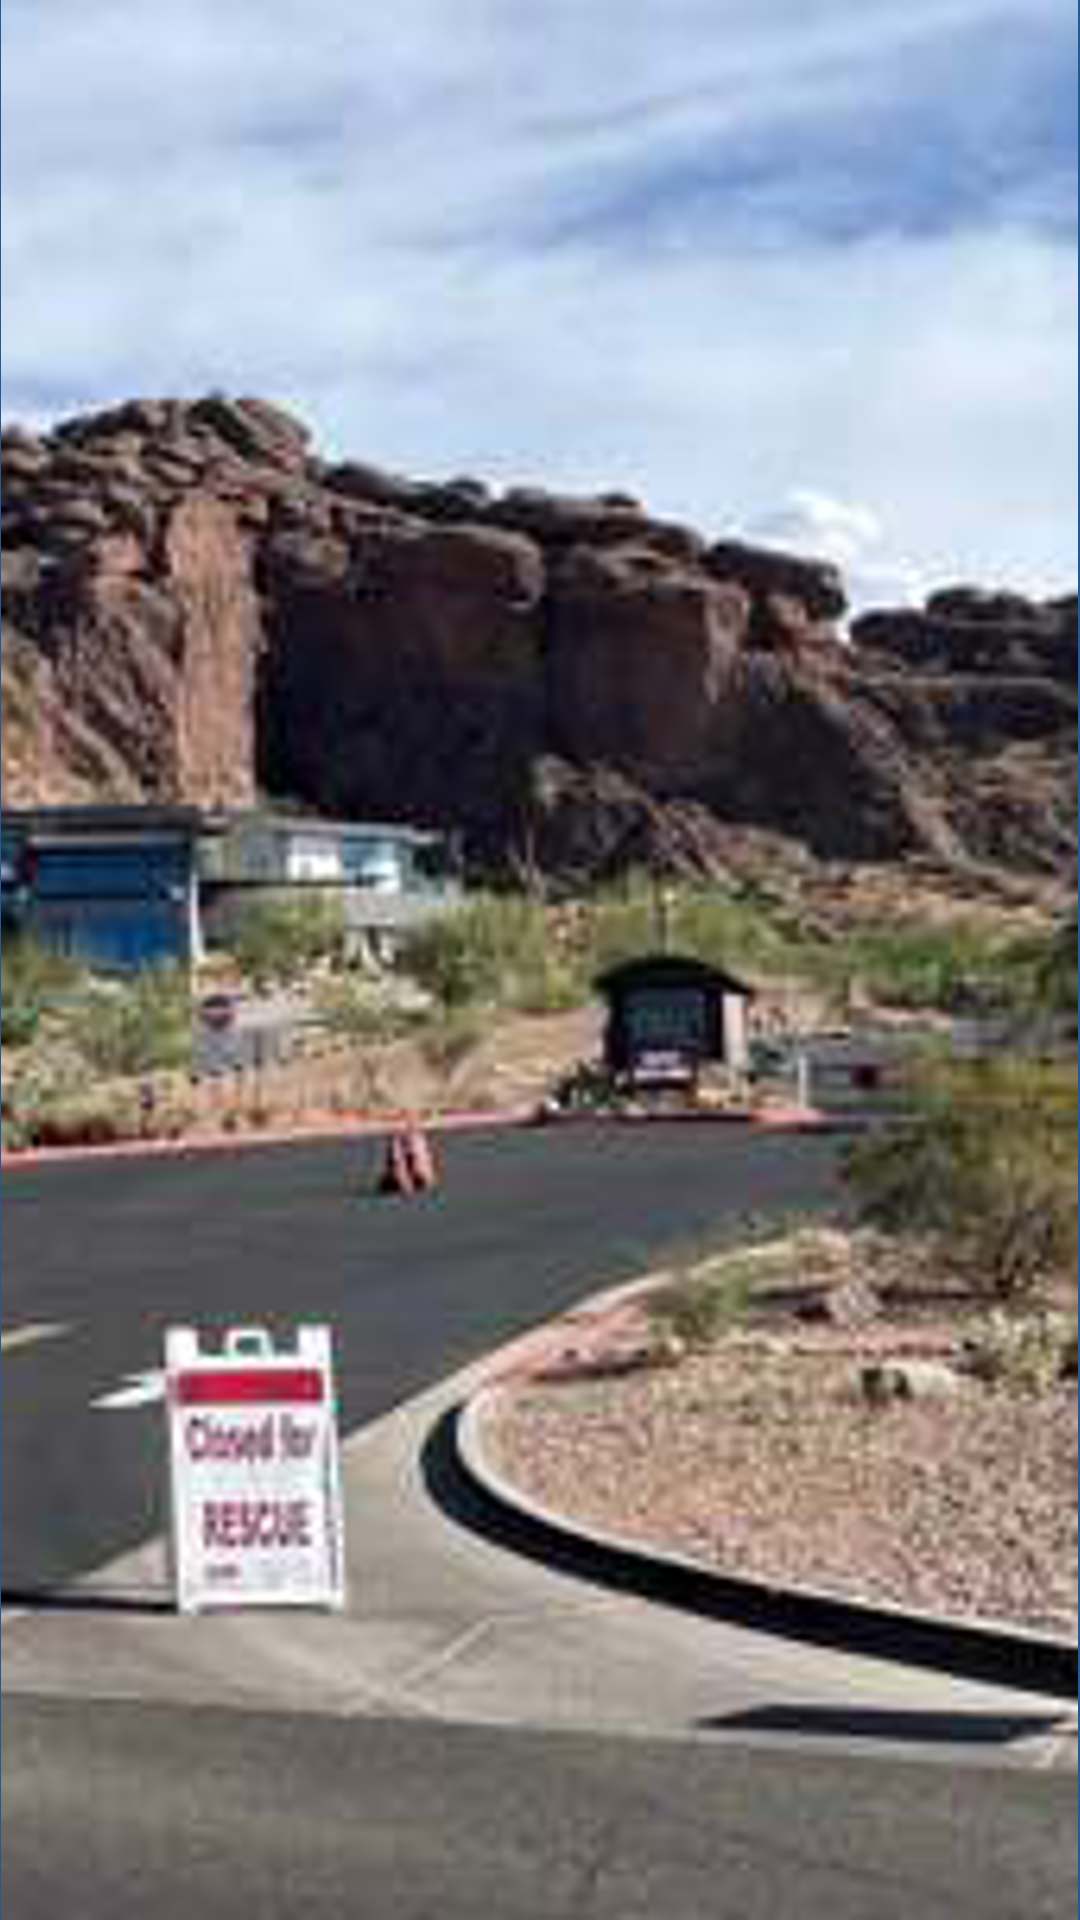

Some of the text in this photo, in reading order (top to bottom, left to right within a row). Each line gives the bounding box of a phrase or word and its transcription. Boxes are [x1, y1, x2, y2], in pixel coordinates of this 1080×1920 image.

[186, 1413, 317, 1462] Closed for
[203, 1501, 313, 1548] RESCUE
